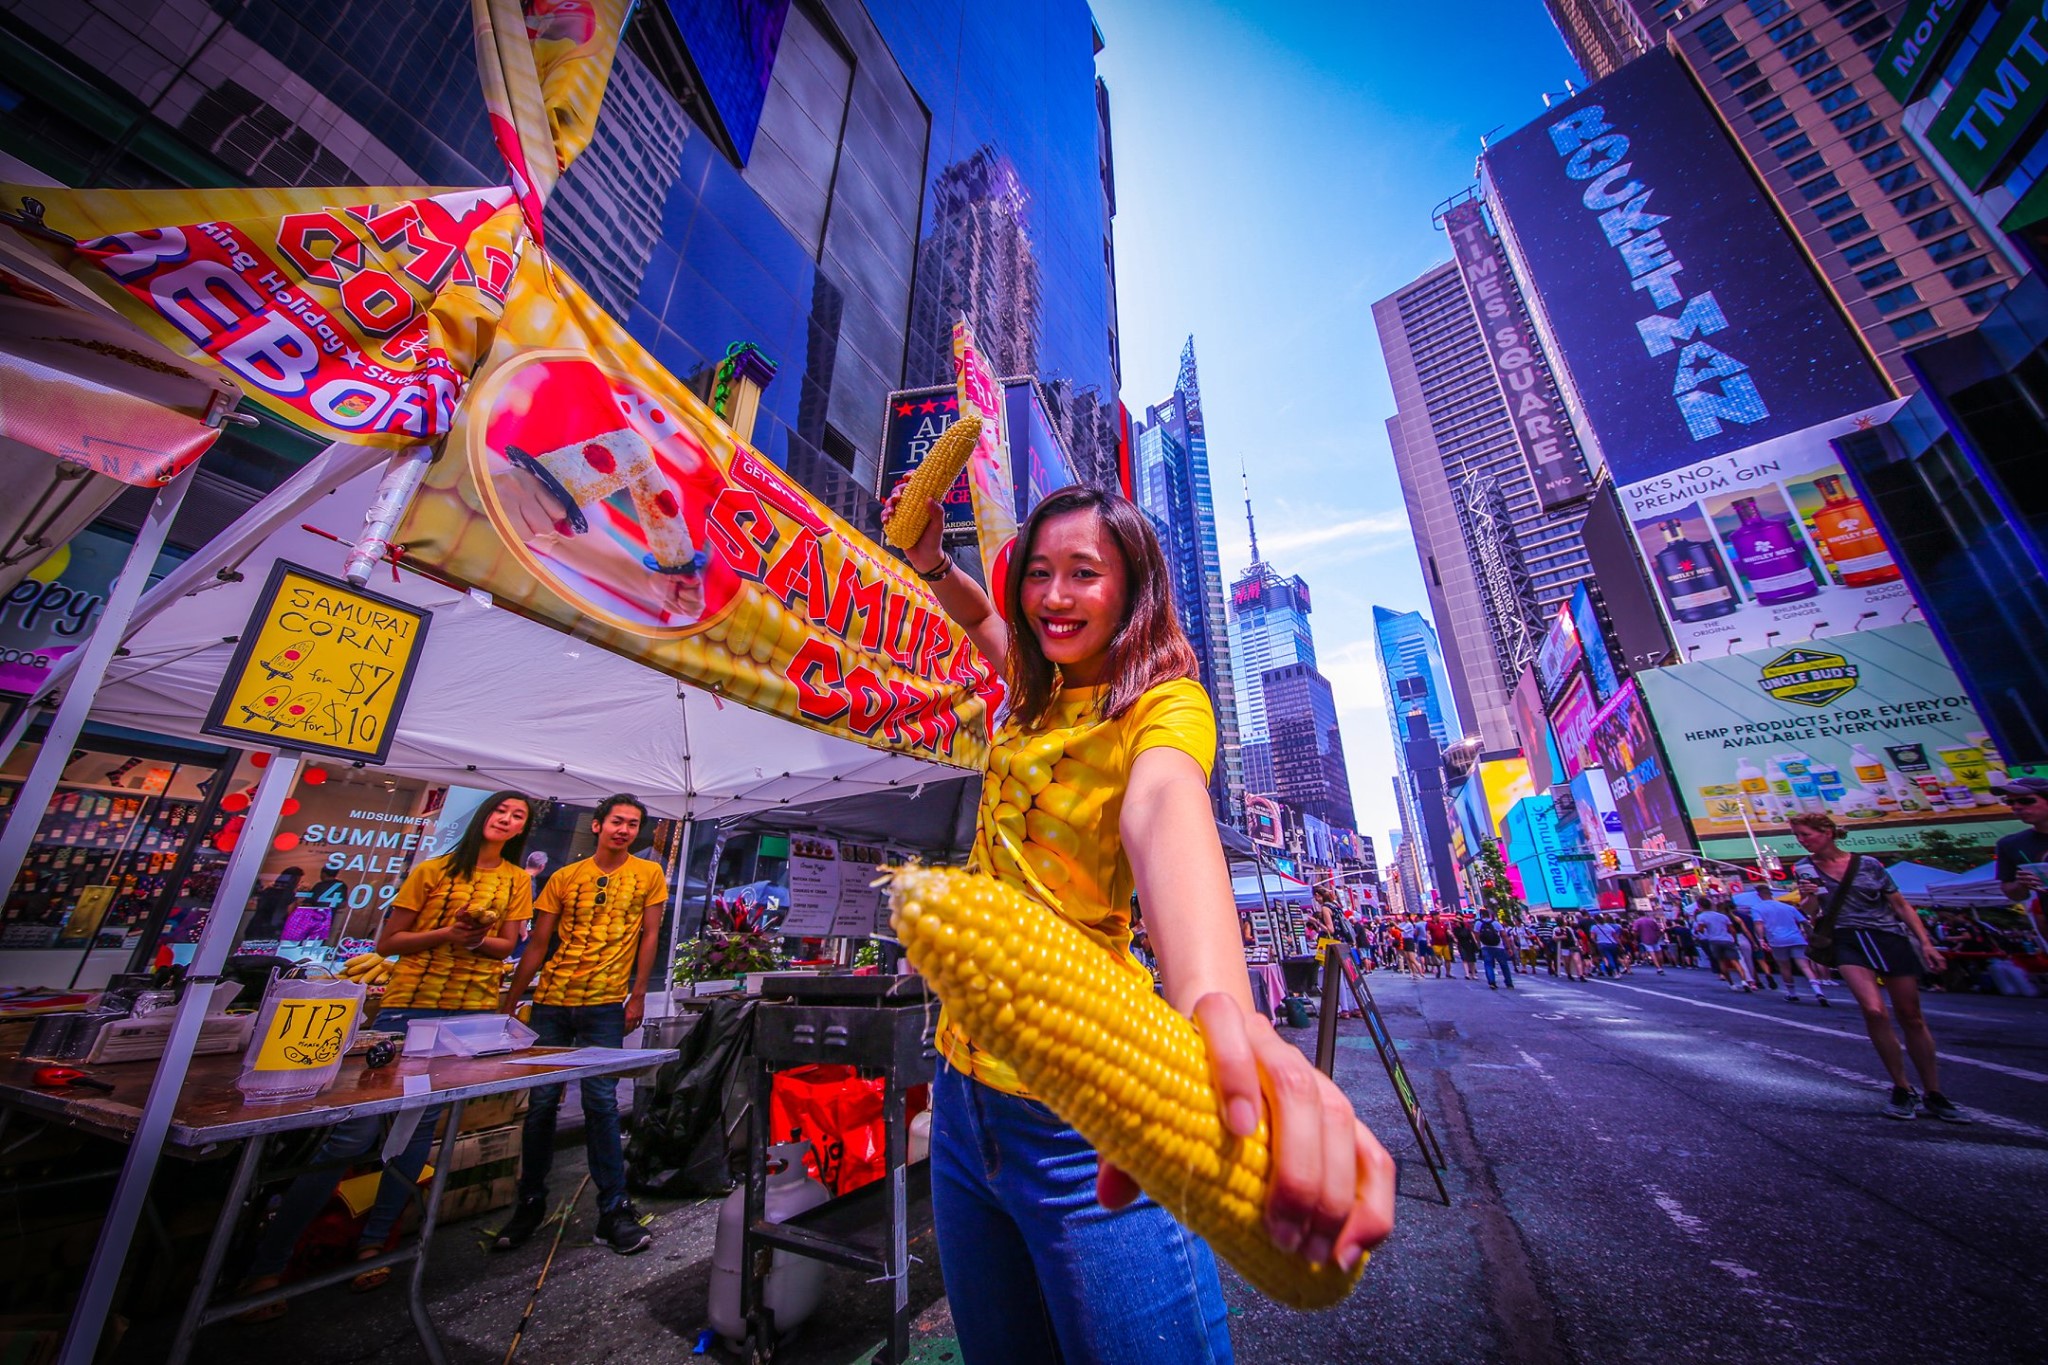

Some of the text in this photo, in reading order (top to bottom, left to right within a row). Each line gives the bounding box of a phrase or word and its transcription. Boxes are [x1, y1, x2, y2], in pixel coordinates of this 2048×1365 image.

[1950, 0, 2048, 151] TMT
[259, 271, 344, 353] Holiday
[1454, 221, 1564, 466] TIMES SQUARE
[743, 459, 769, 483] GET
[1545, 475, 1573, 491] NYC
[1628, 457, 1739, 499] UK'S NO. 1
[1634, 460, 1781, 512] PREMIUM GIN
[705, 488, 1000, 697] SAMURAI
[1772, 602, 1817, 615] RHUBARB
[1864, 588, 1913, 603] ORANG
[1866, 584, 1904, 596] BLOOD
[289, 587, 411, 639] SAMURAI
[1693, 625, 1737, 638] ORIGINAL
[1703, 620, 1720, 629] THE
[1783, 608, 1823, 621] GINGER
[278, 611, 395, 657] CORN
[308, 660, 396, 707] for $7
[785, 638, 957, 755] CORN
[1760, 672, 1809, 690] UNCLE
[1809, 666, 1858, 681] BUD'S
[301, 699, 378, 745] for $10
[1685, 694, 1973, 742] HEMP PRODUCTS FOR EVERYON
[1722, 710, 1962, 749] AVAILABLE EVERYWHERE.
[349, 809, 430, 826] MIDSUMMER
[303, 823, 439, 852] SUMMER
[1532, 805, 1567, 895] amazon music
[325, 851, 405, 875] SALE
[278, 1003, 347, 1040] TIP
